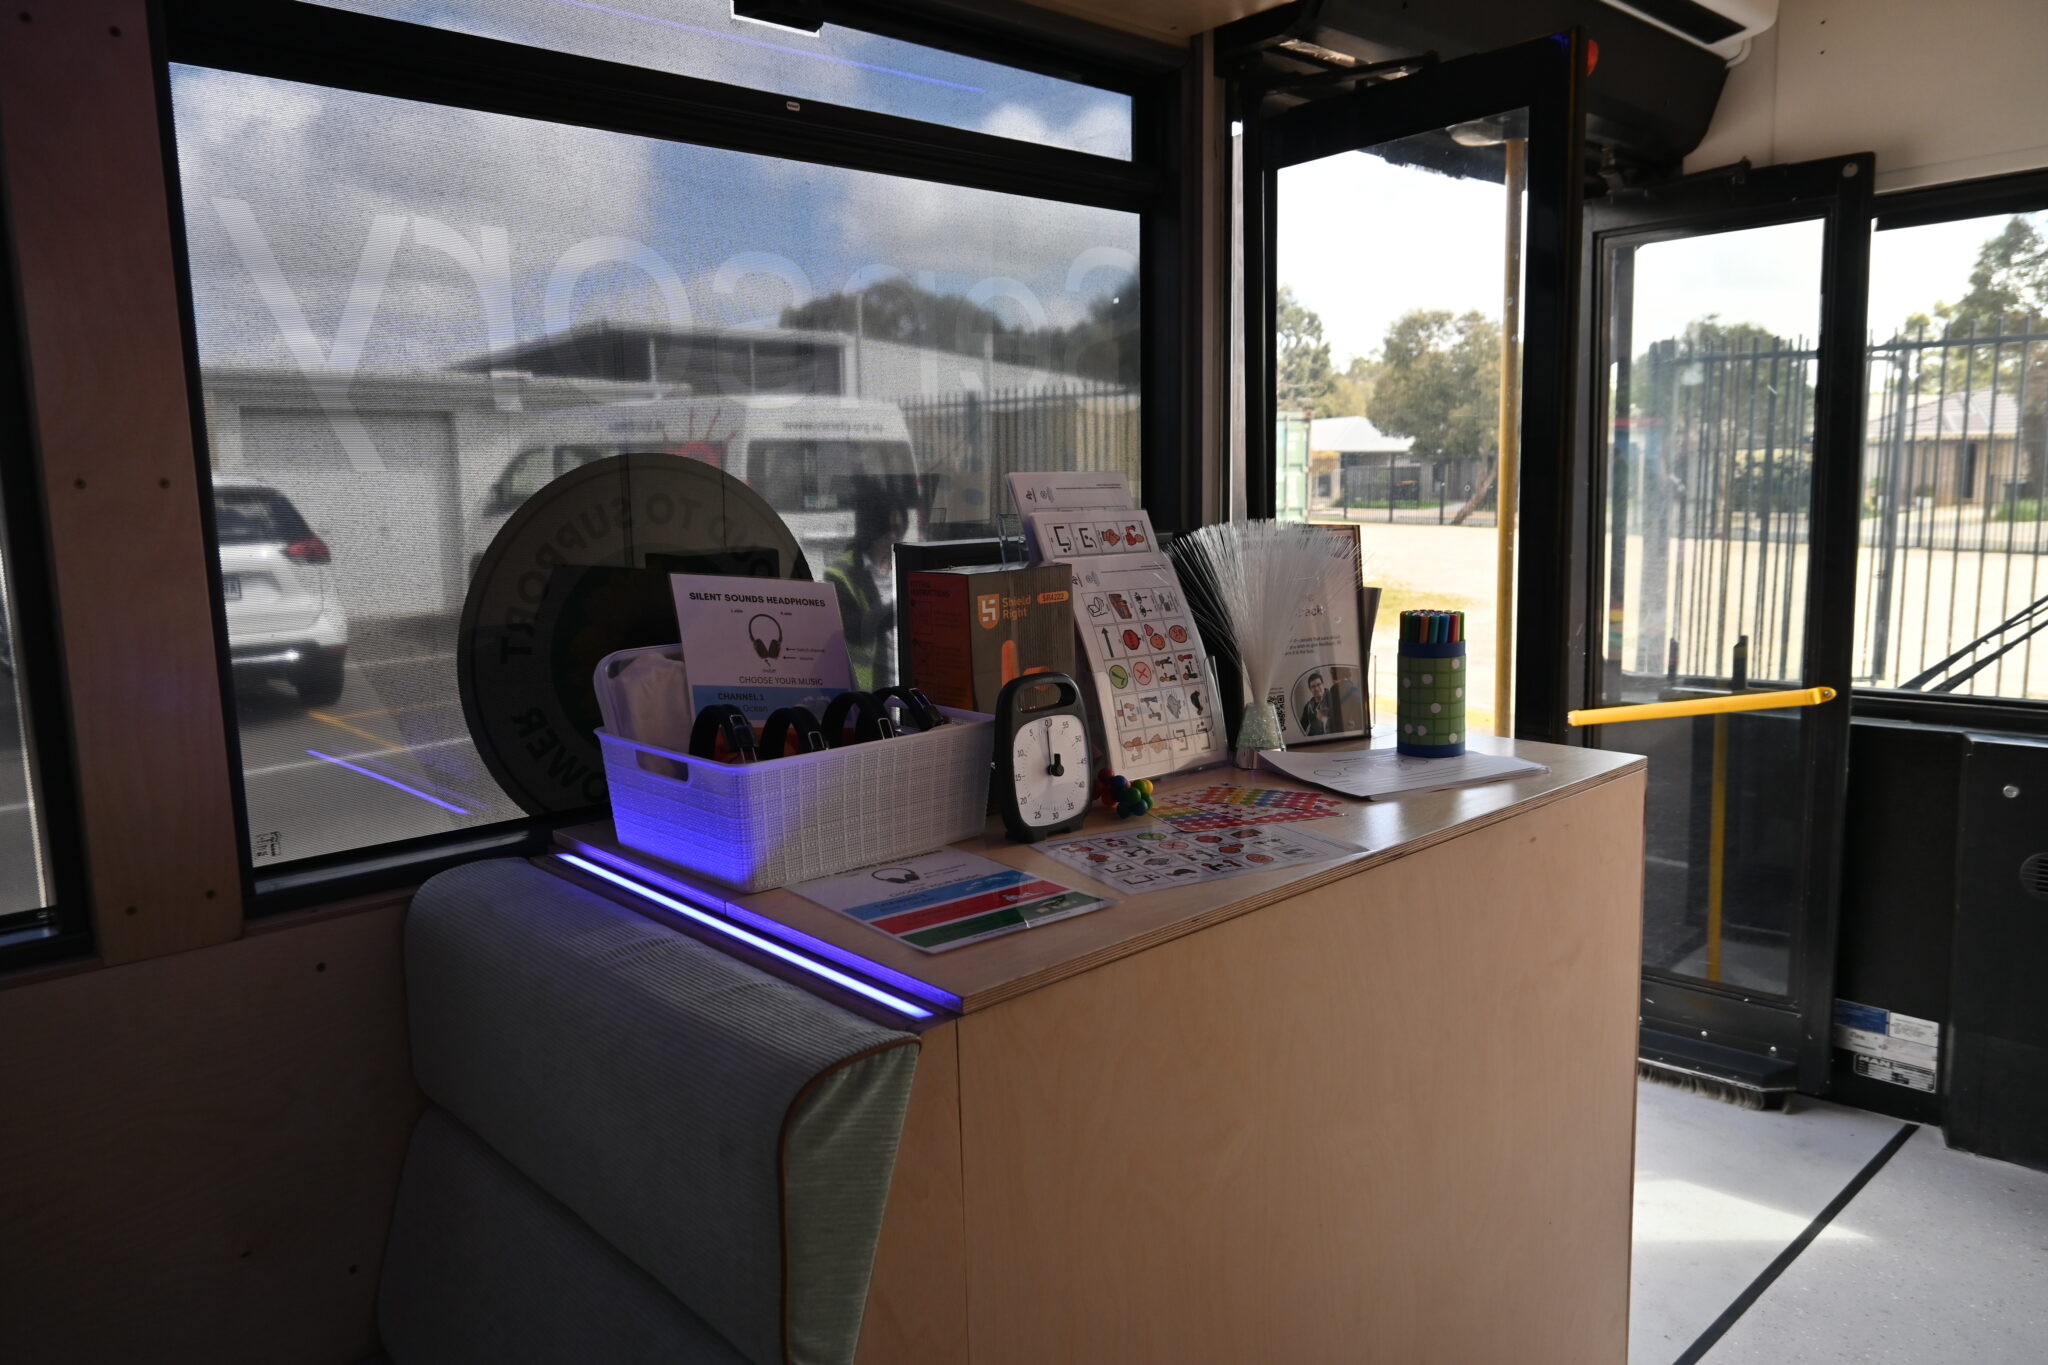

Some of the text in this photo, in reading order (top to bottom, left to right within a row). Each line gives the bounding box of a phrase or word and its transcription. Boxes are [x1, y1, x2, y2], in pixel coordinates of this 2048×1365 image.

[689, 592, 826, 608] SILENT SOUNDS HEADPHONES
[1002, 596, 1032, 608] Shield
[1002, 608, 1029, 620] Right
[738, 676, 824, 686] CHOOSE YOUR MUSIC
[717, 692, 759, 701] CHANNEL
[1015, 773, 1022, 782] 15
[1034, 811, 1042, 819] 25
[1052, 811, 1059, 819] 30
